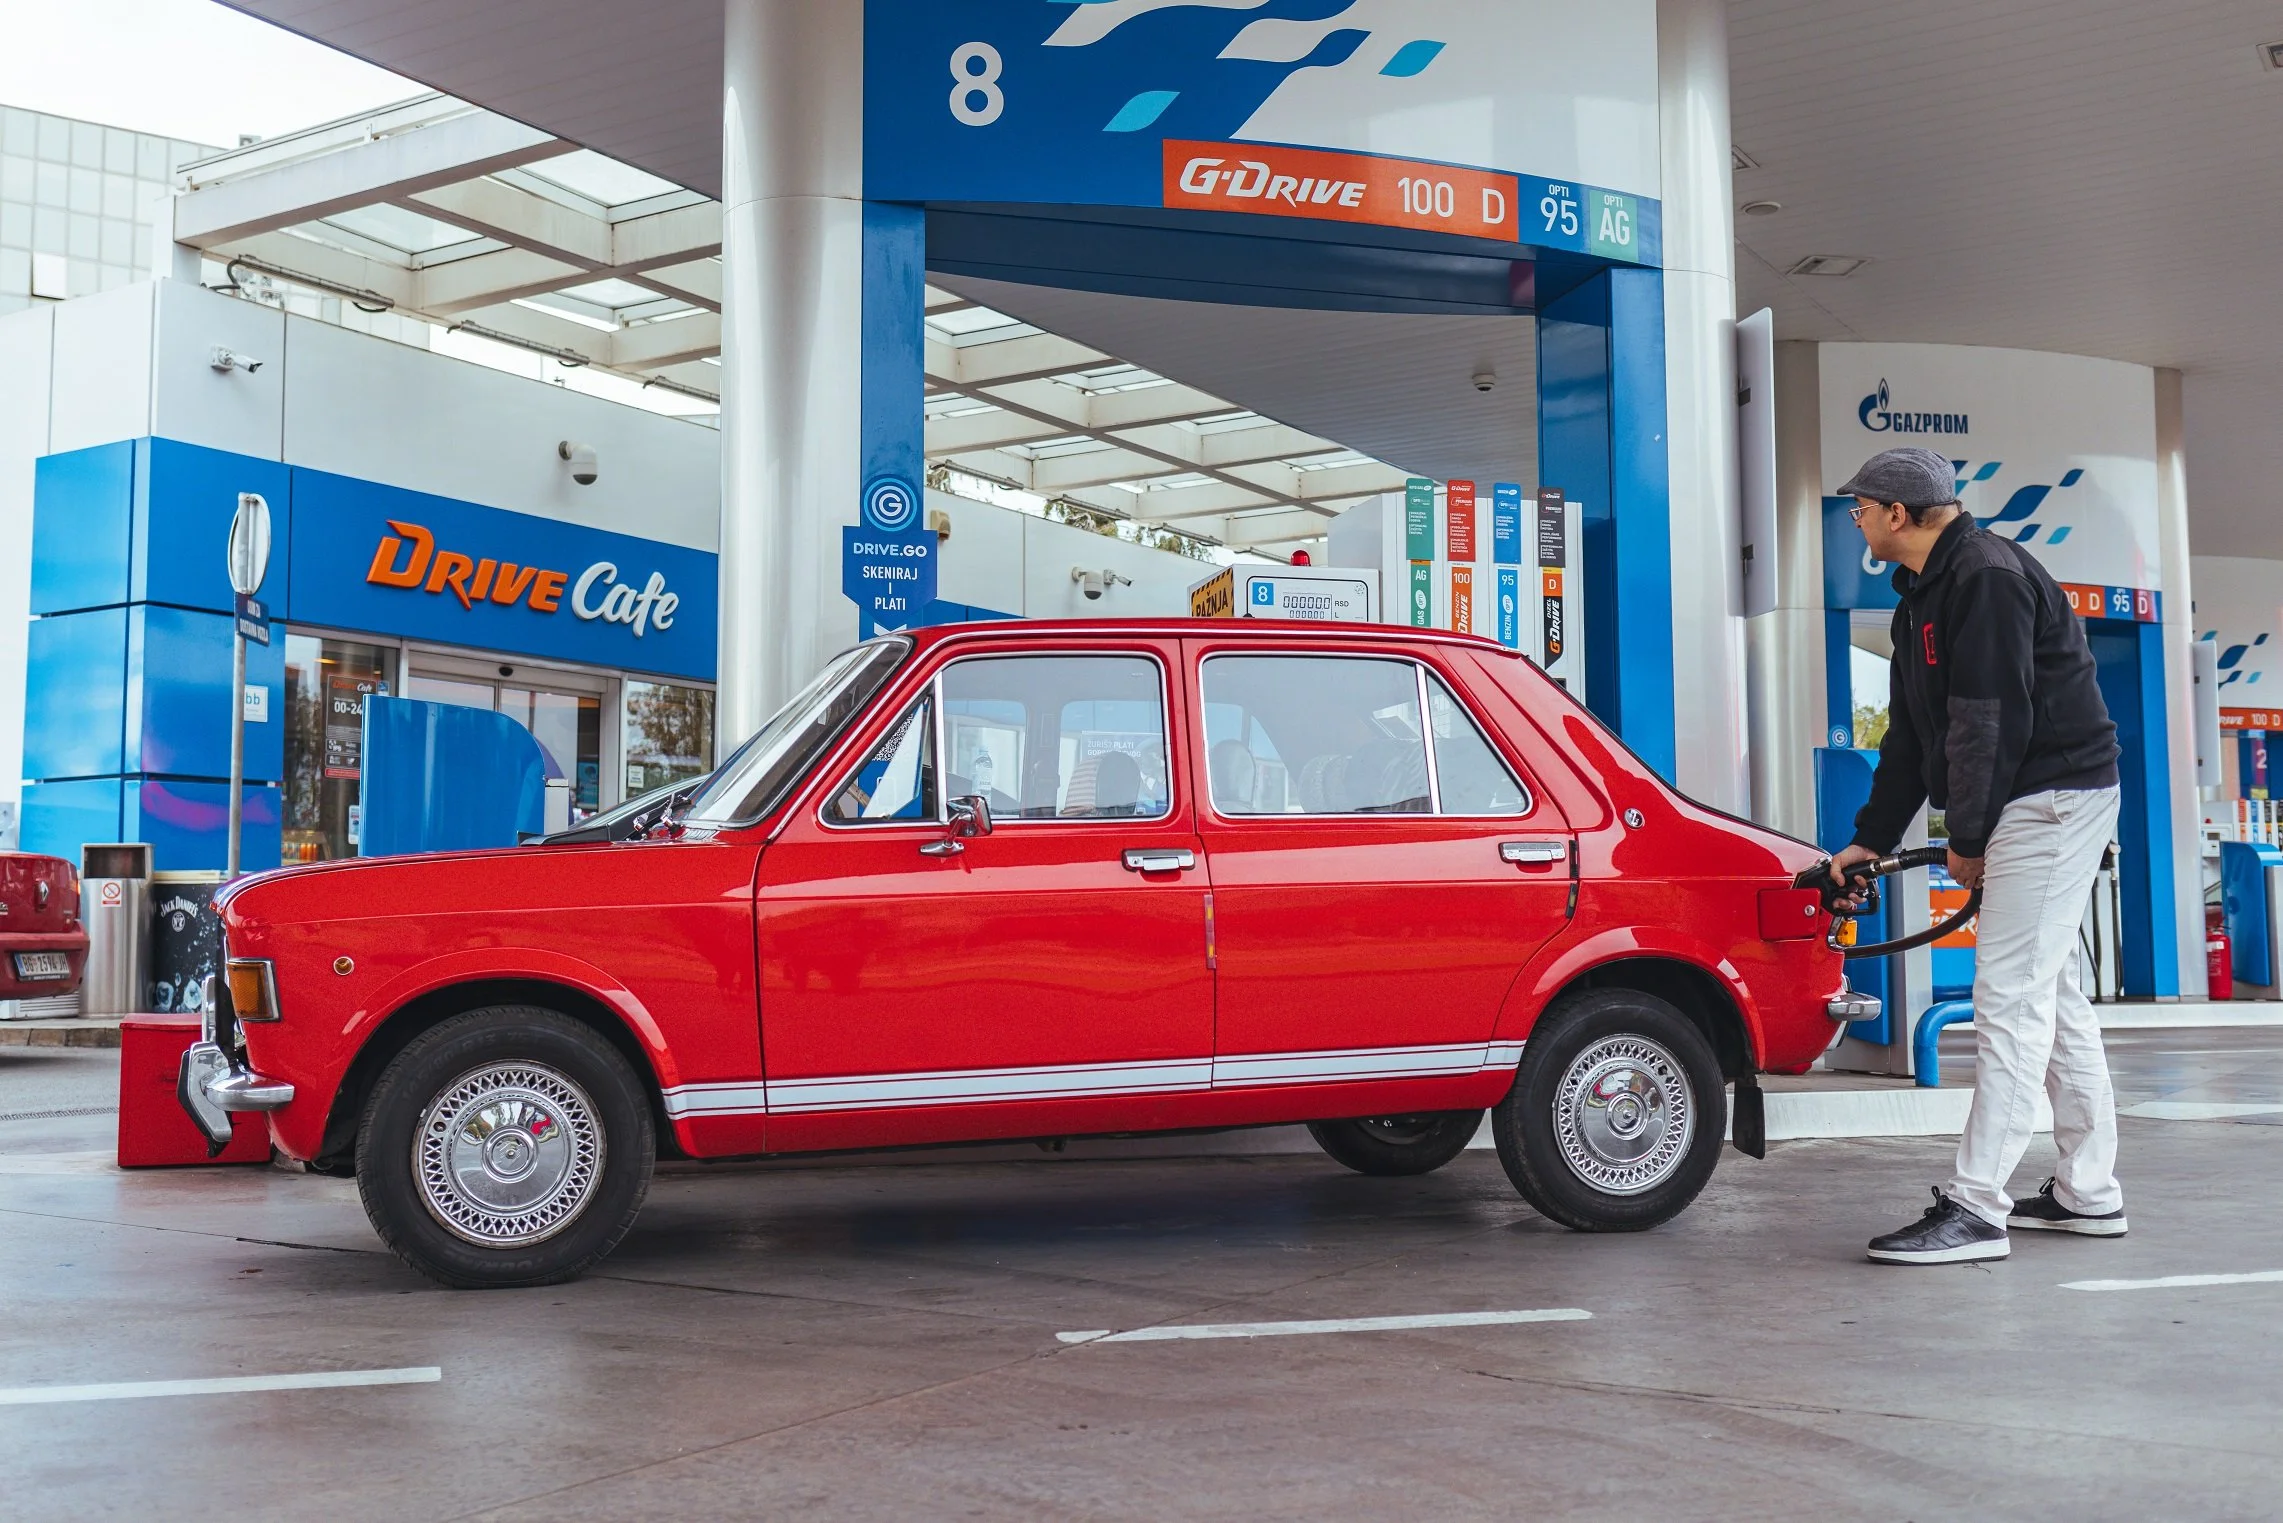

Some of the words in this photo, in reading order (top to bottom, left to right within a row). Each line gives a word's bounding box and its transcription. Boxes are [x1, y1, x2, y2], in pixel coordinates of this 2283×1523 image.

[949, 41, 1004, 126] 8
[1548, 184, 1569, 198] OPTI
[1397, 177, 1454, 218] 100
[1482, 187, 1505, 225] D
[1604, 194, 1623, 208] OPTI
[1540, 197, 1578, 236] 95
[1599, 208, 1630, 246] AG
[1893, 412, 1968, 434] GAZPROM
[853, 542, 928, 558] DRIVE.GO
[366, 520, 568, 612] DRIVE
[571, 561, 679, 638] Cafe
[863, 565, 918, 580] SKENIRAJ
[1415, 570, 1427, 581] AG
[1453, 572, 1470, 584] 100
[1502, 575, 1514, 586] 95
[888, 582, 892, 594] I
[1548, 579, 1556, 590] D
[1258, 586, 1269, 602] 8
[2089, 593, 2100, 611] D
[875, 597, 906, 610] PLATI
[2113, 594, 2130, 612] 95
[2138, 597, 2148, 614] D
[1417, 610, 1425, 625] GAS
[1458, 594, 1469, 634] DRIVE
[1504, 615, 1512, 640] BENZIN
[160, 899, 175, 918] JACK
